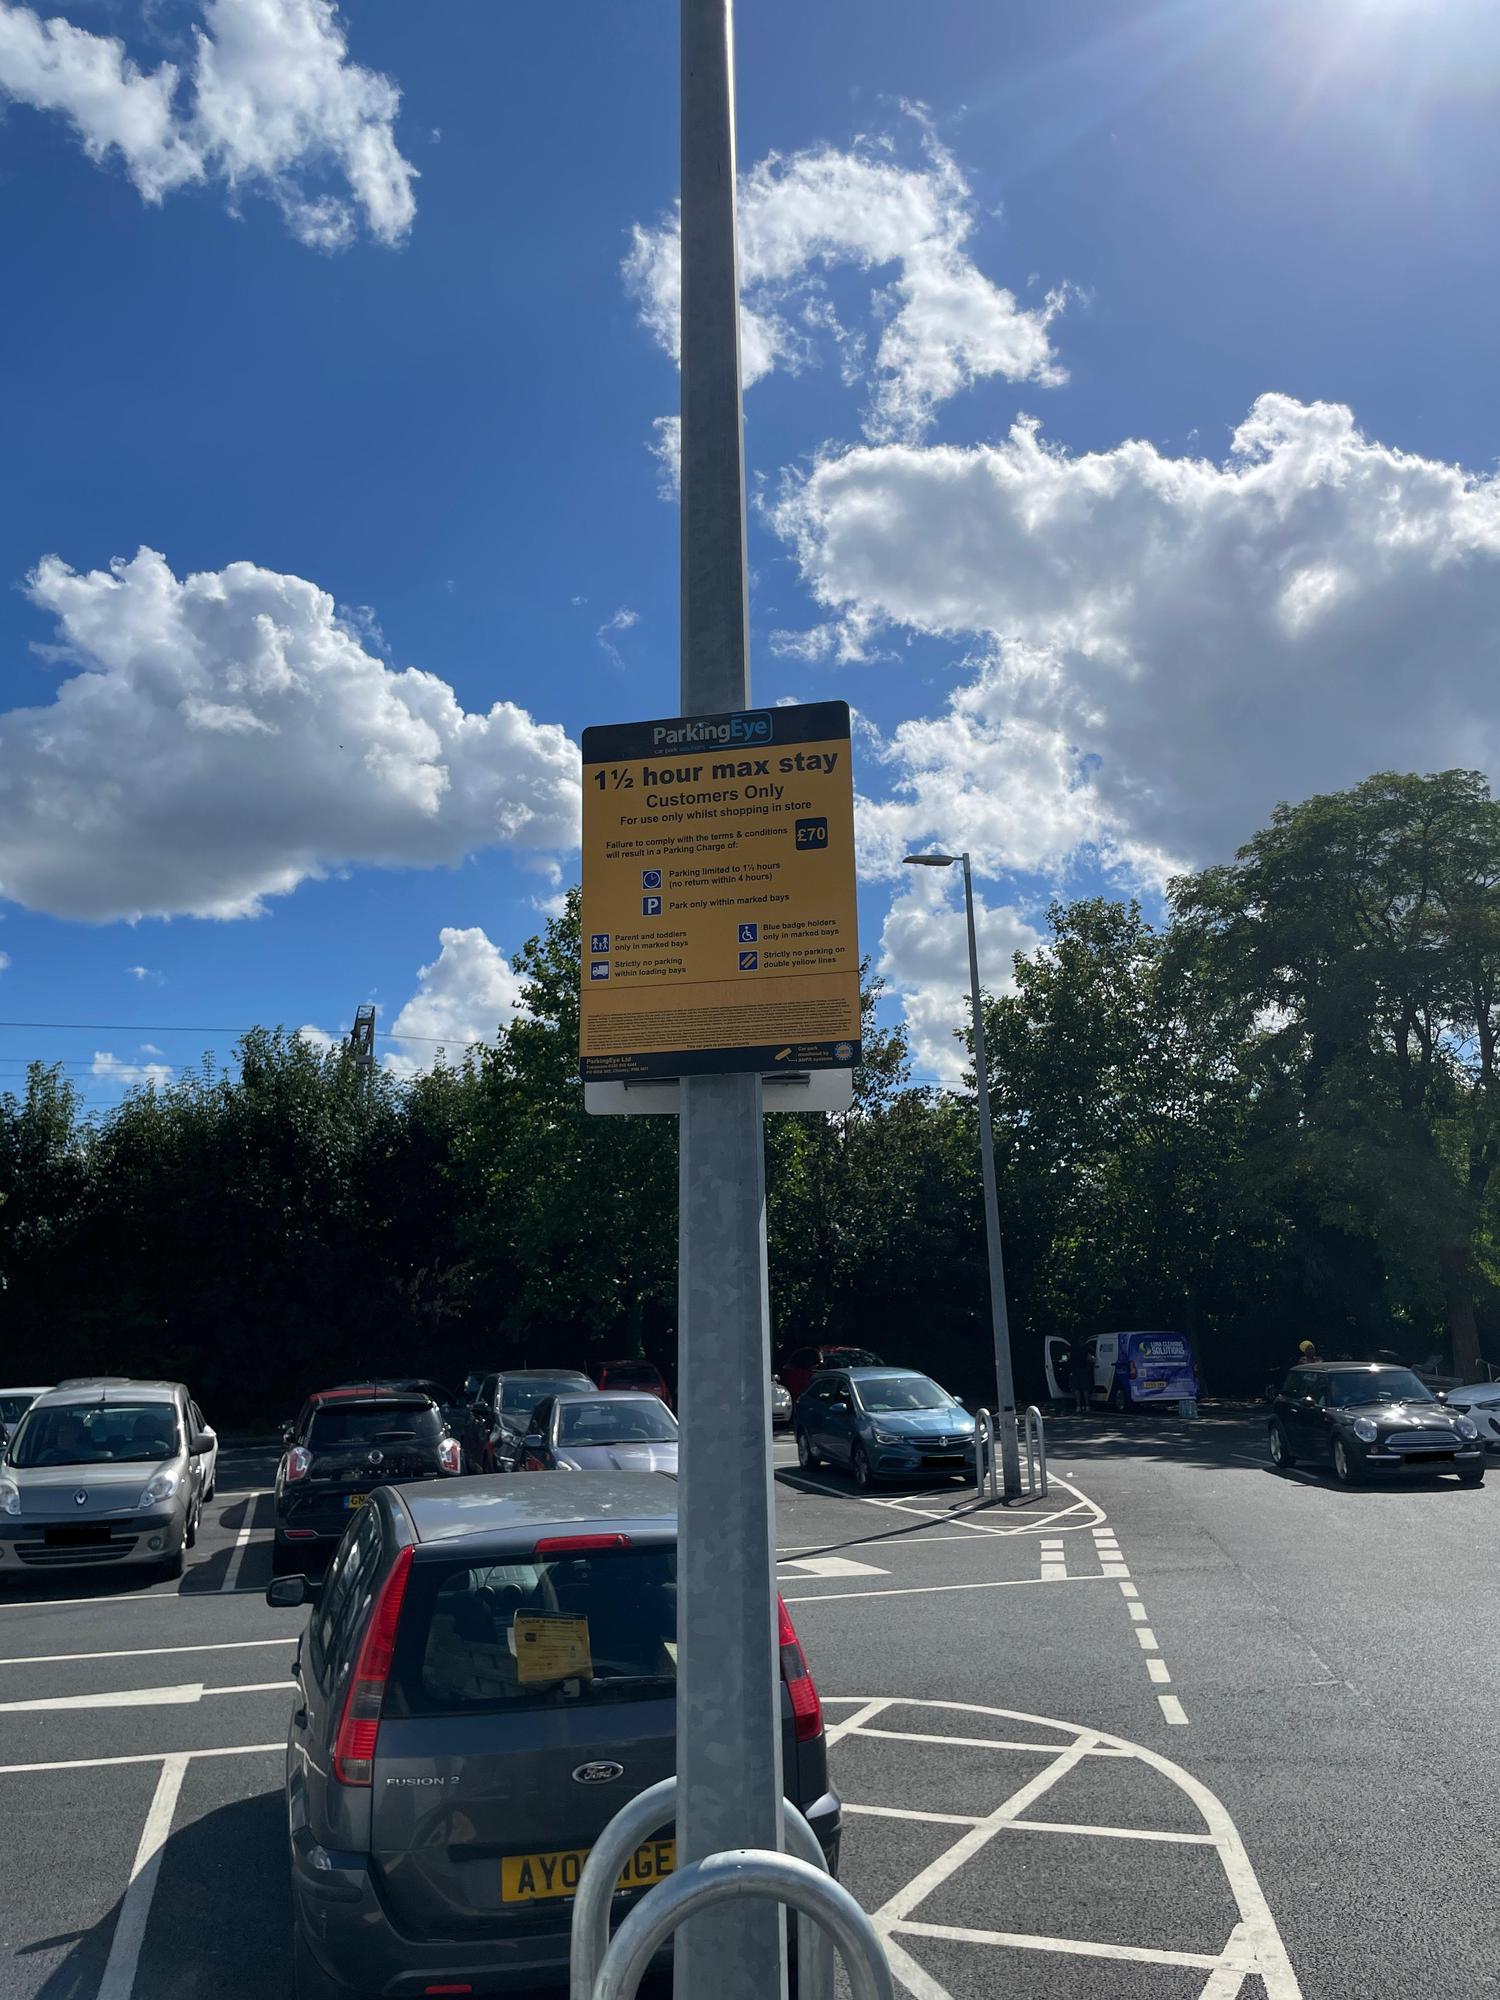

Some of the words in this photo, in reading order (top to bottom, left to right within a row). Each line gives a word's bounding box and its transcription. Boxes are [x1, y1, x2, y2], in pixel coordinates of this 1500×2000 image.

[653, 719, 767, 745] ParkingEye
[643, 766, 703, 787] hour
[712, 760, 770, 780] max
[779, 752, 839, 775] stay
[646, 789, 738, 808] Customers
[744, 783, 784, 800] Only
[621, 817, 638, 825] For
[662, 812, 683, 822] only
[687, 810, 717, 819] whilst
[720, 805, 768, 816] shopping
[772, 803, 781, 812] in
[785, 802, 811, 810] store
[646, 837, 675, 846] comply
[745, 828, 788, 837] conditions
[797, 827, 825, 842] £70
[622, 849, 644, 858] result
[702, 866, 729, 874] limited
[670, 881, 682, 889] (no
[746, 872, 772, 881] hours)
[690, 900, 707, 908] only
[737, 895, 767, 904] marked
[791, 930, 819, 938] marked
[804, 948, 833, 956] parking
[792, 959, 816, 967] yellow
[584, 1766, 613, 1780] Ford
[386, 1777, 444, 1786] FUSION
[450, 1775, 461, 1786] 2
